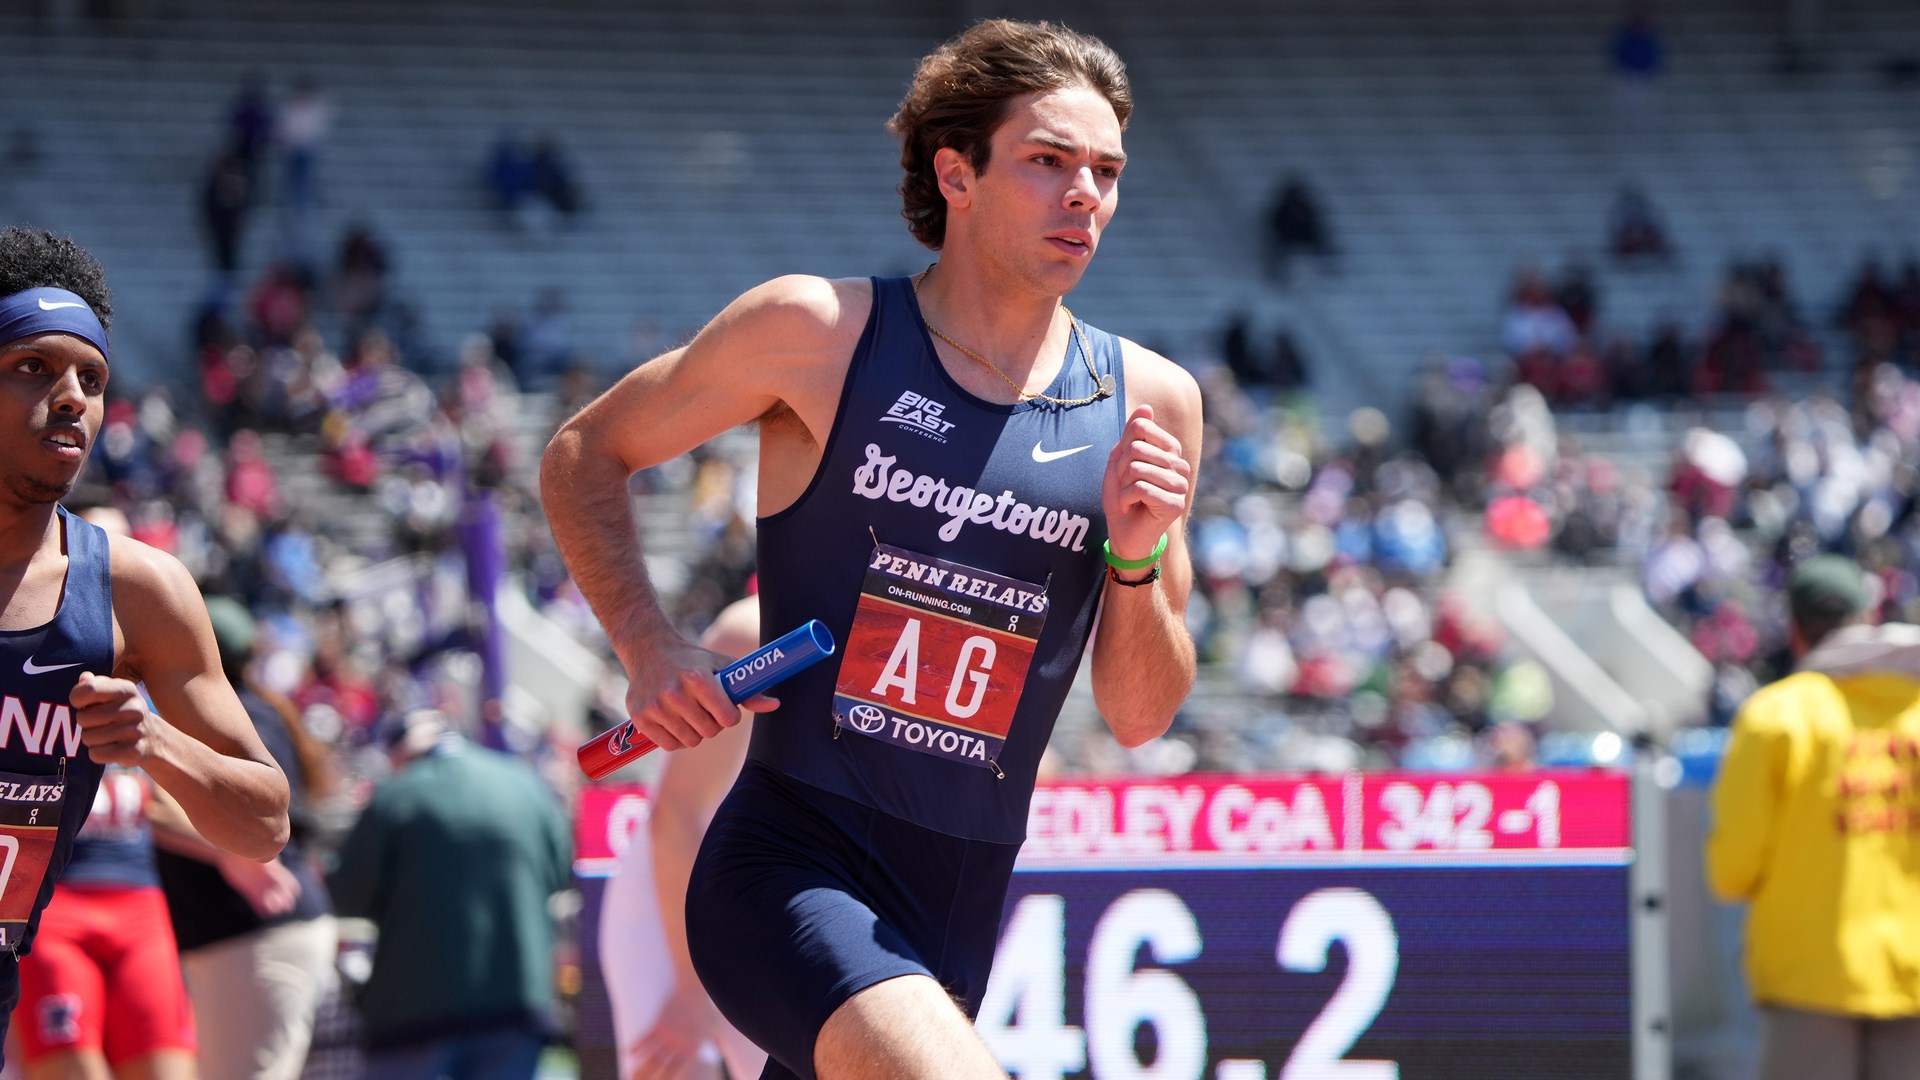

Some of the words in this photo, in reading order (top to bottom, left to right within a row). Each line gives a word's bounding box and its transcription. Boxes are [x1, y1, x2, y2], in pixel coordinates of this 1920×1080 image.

[886, 402, 956, 433] EAST
[897, 390, 946, 417] BIG
[898, 424, 948, 444] CONFERENCE
[852, 443, 1090, 552] Georgetown
[869, 551, 949, 588] PENN
[947, 576, 1048, 614] RELAYS
[887, 585, 972, 616] ON-RUNNING.COM
[725, 647, 785, 686] TOYOTA
[870, 617, 921, 705] A
[944, 635, 997, 719] G
[891, 717, 987, 761] TOYOTA
